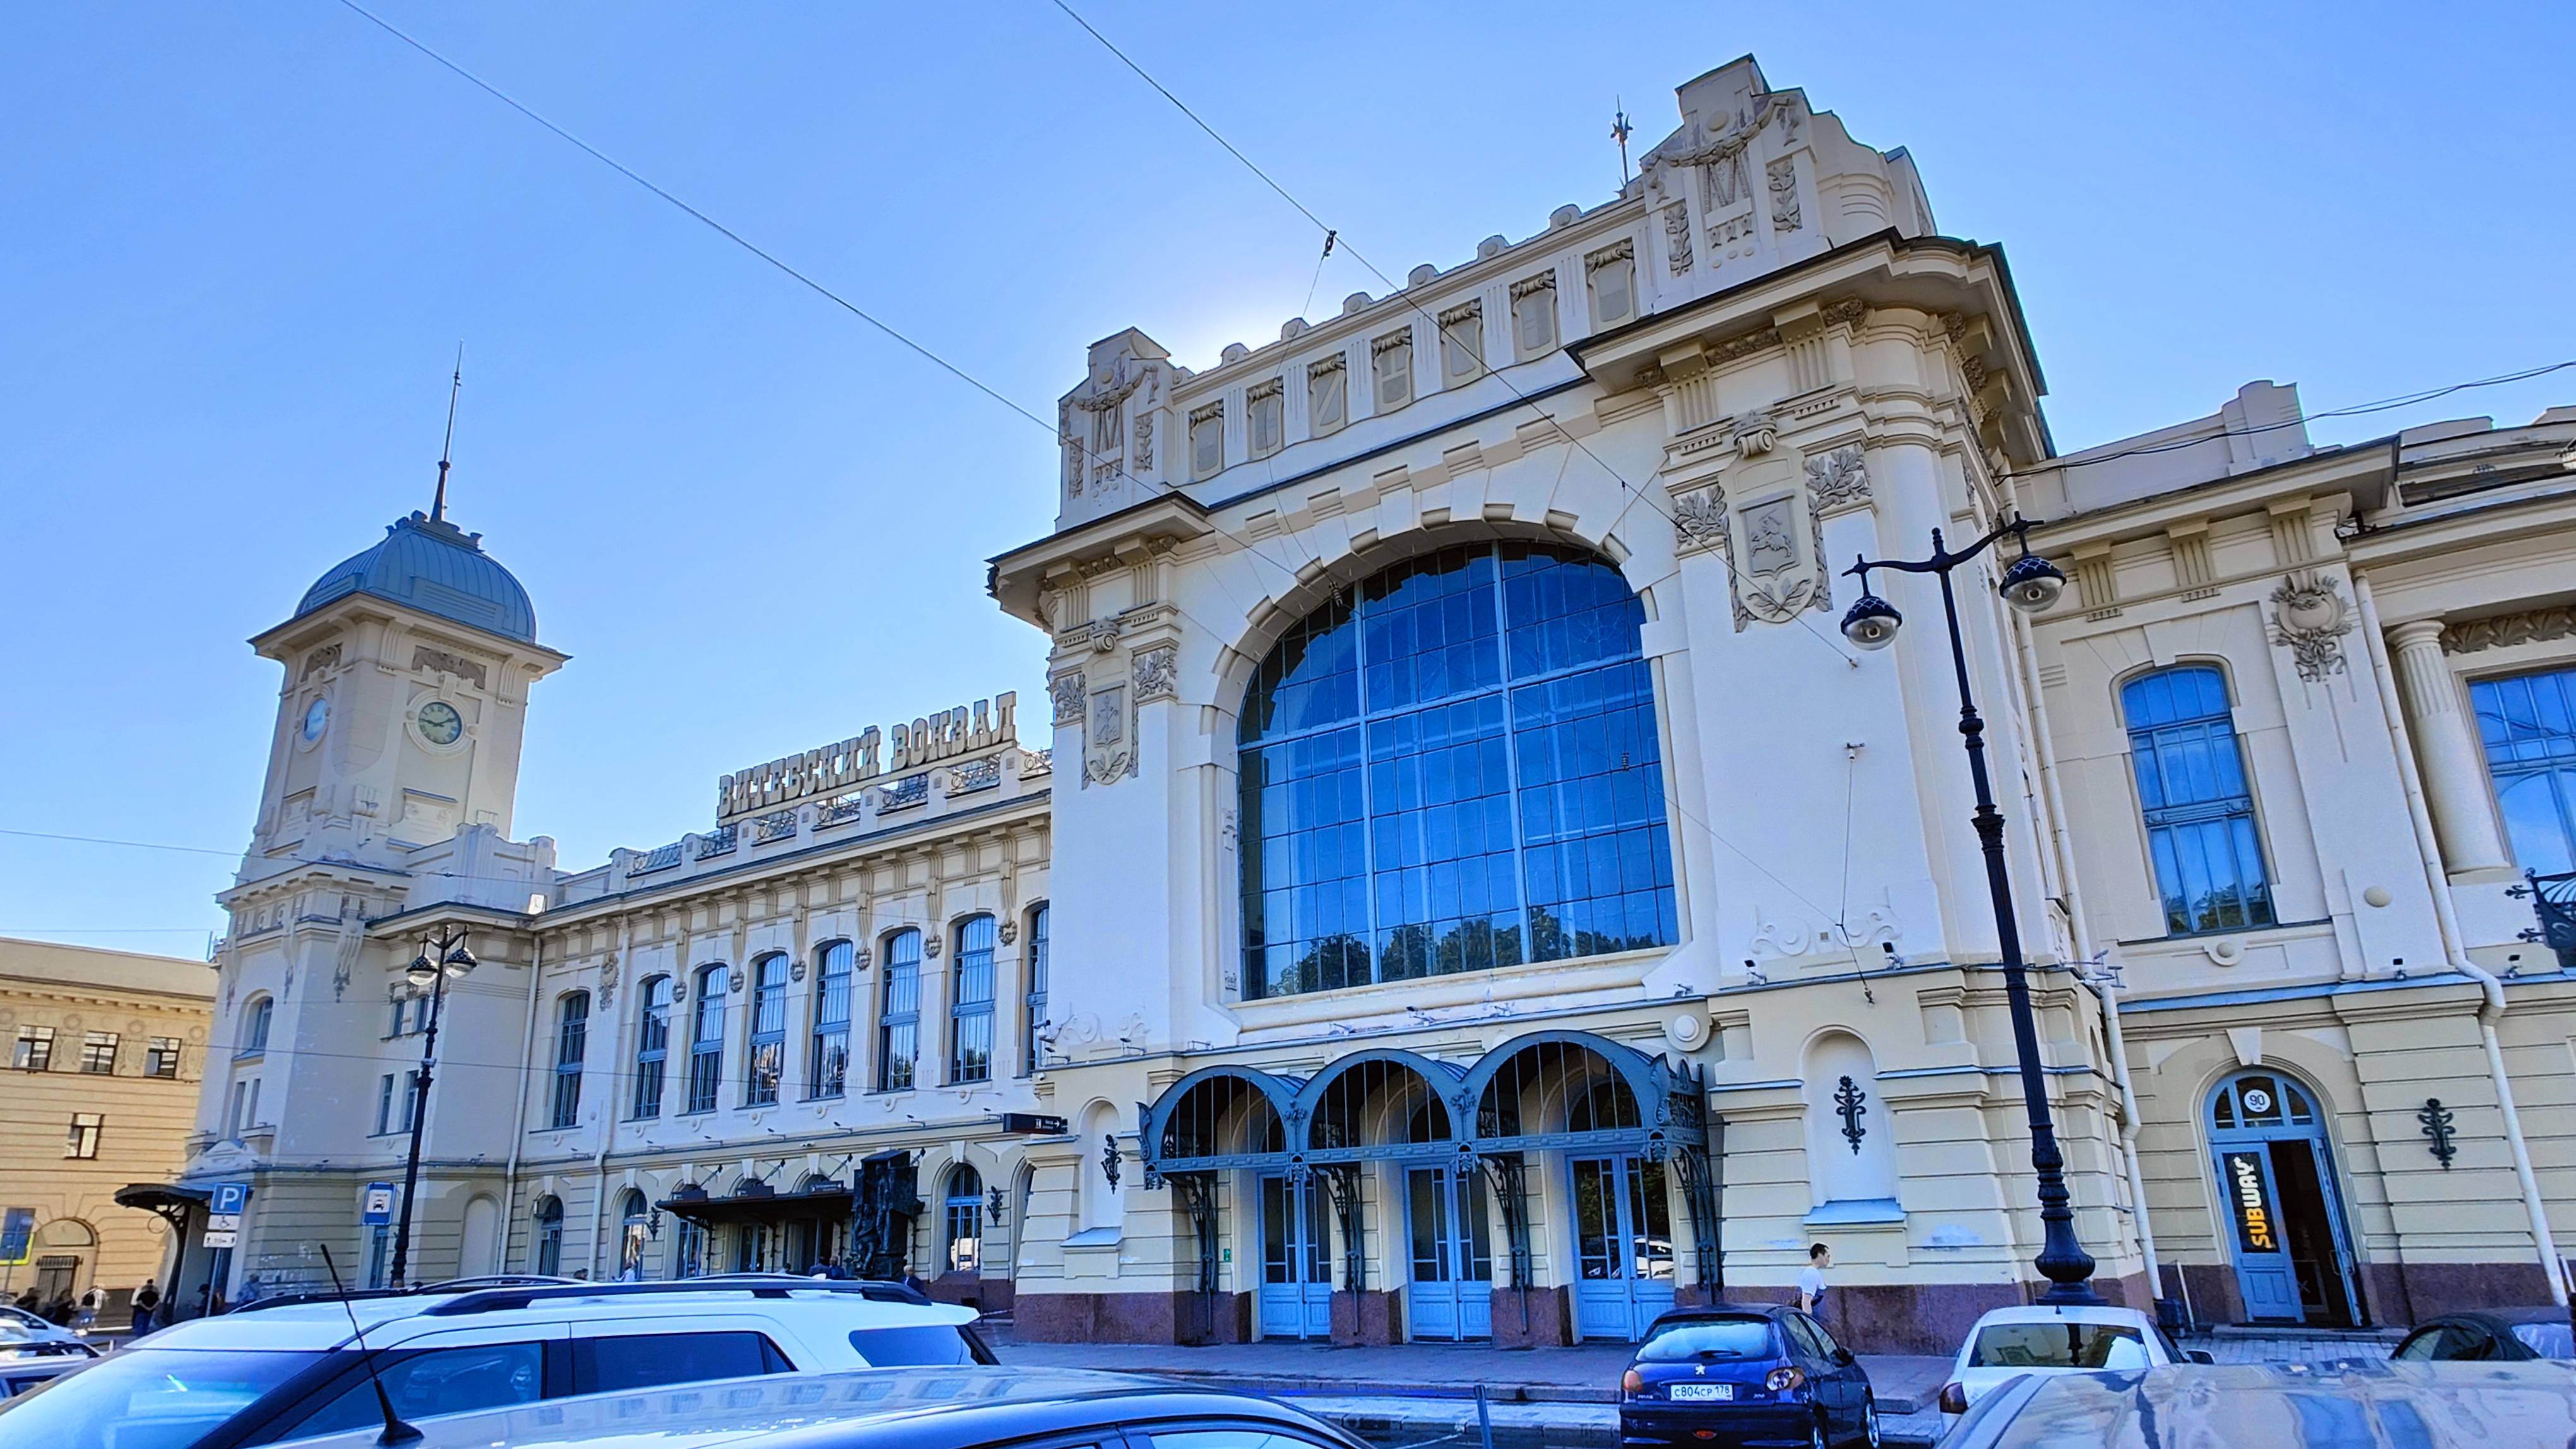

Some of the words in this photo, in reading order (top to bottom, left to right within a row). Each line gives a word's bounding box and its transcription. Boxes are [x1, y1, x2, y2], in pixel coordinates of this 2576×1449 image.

[717, 725, 881, 818] ВИТЕБСКИЙ
[891, 691, 1017, 772] ВОКЗАЛ
[2249, 1094, 2265, 1106] 90
[220, 1188, 239, 1210] P
[2233, 1157, 2276, 1249] SUBWAY
